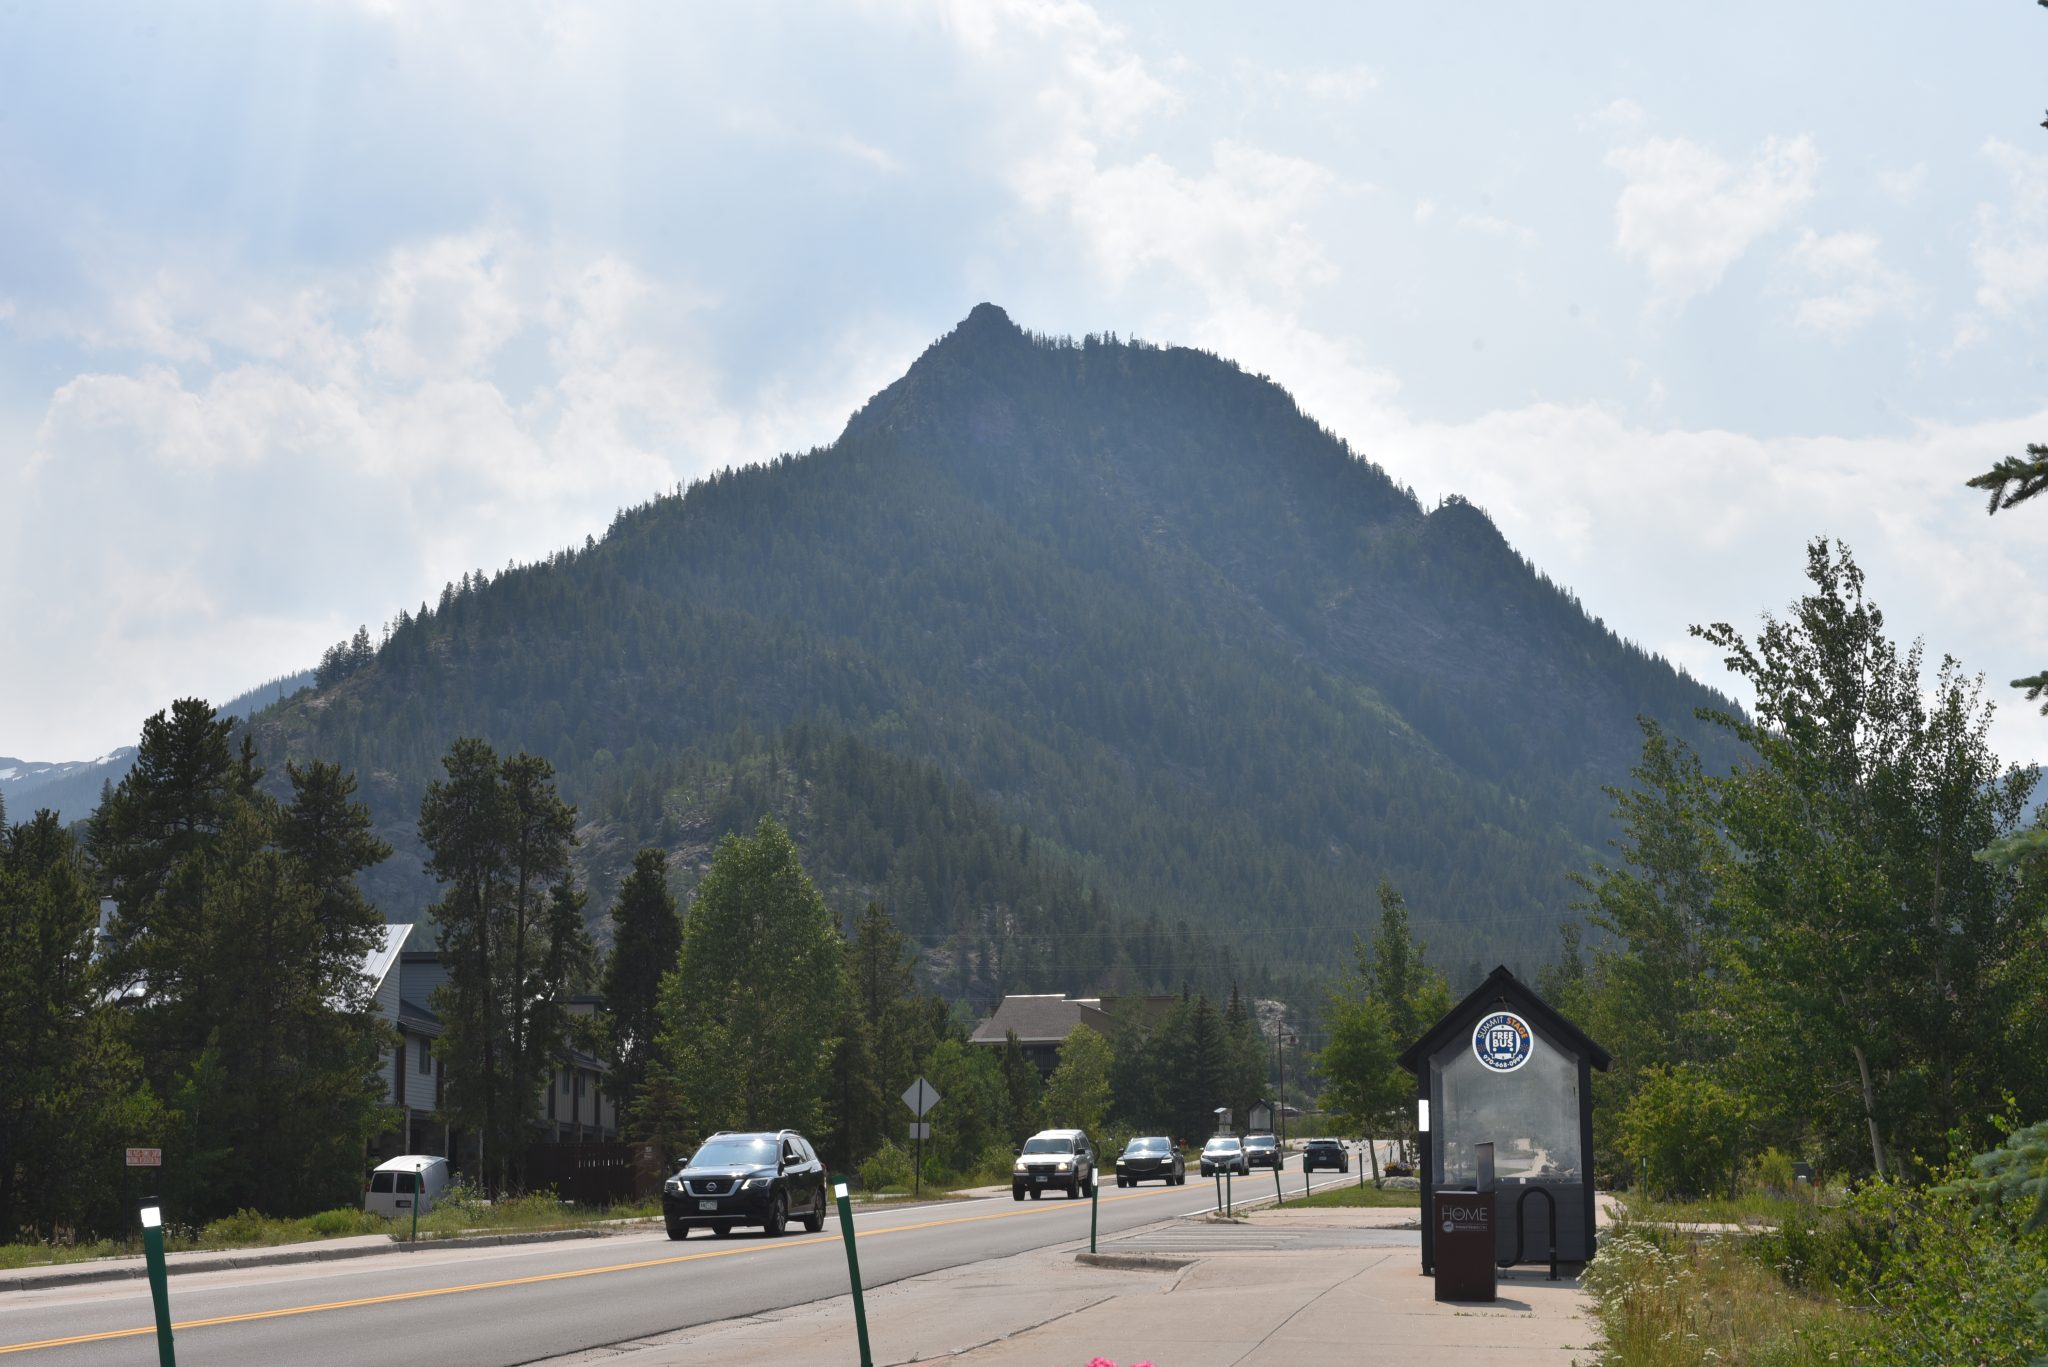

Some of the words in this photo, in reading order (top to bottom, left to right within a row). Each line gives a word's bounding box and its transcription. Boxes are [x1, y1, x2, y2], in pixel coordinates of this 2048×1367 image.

[1478, 1016, 1503, 1039] SUMMIT
[1506, 1017, 1528, 1039] STAGE
[1492, 1031, 1514, 1040] FREE
[1492, 1039, 1514, 1048] BUS
[1441, 1207, 1488, 1221] HOME
